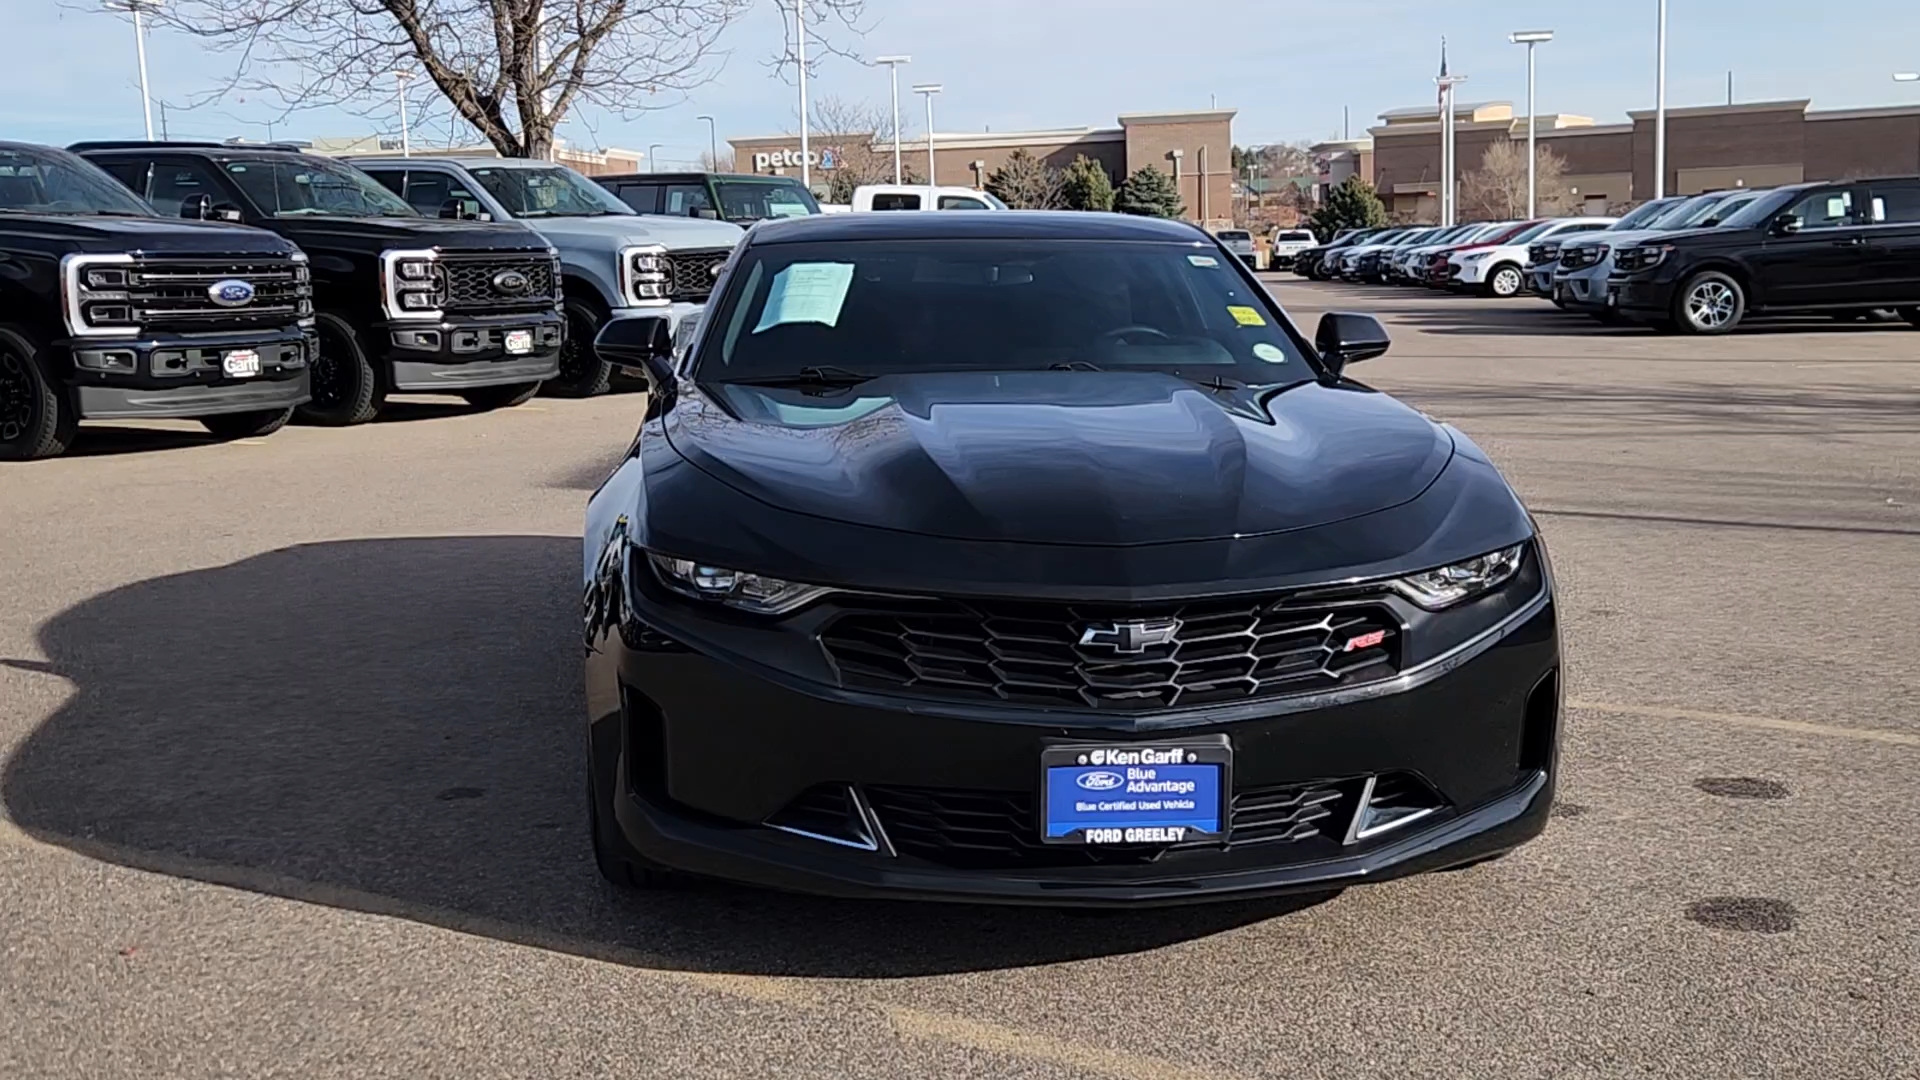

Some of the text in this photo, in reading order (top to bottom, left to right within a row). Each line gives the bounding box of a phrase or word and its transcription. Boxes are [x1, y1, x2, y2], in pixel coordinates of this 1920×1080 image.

[756, 148, 820, 171] petco
[1343, 629, 1385, 652] RS
[1106, 748, 1184, 765] Ken Garff
[1085, 774, 1115, 789] Ford
[1127, 768, 1156, 780] Blue
[1126, 780, 1195, 794] Advantage
[1076, 800, 1195, 811] Blue Certified Used Vehicle
[1086, 827, 1186, 843] FORD GREELEY
